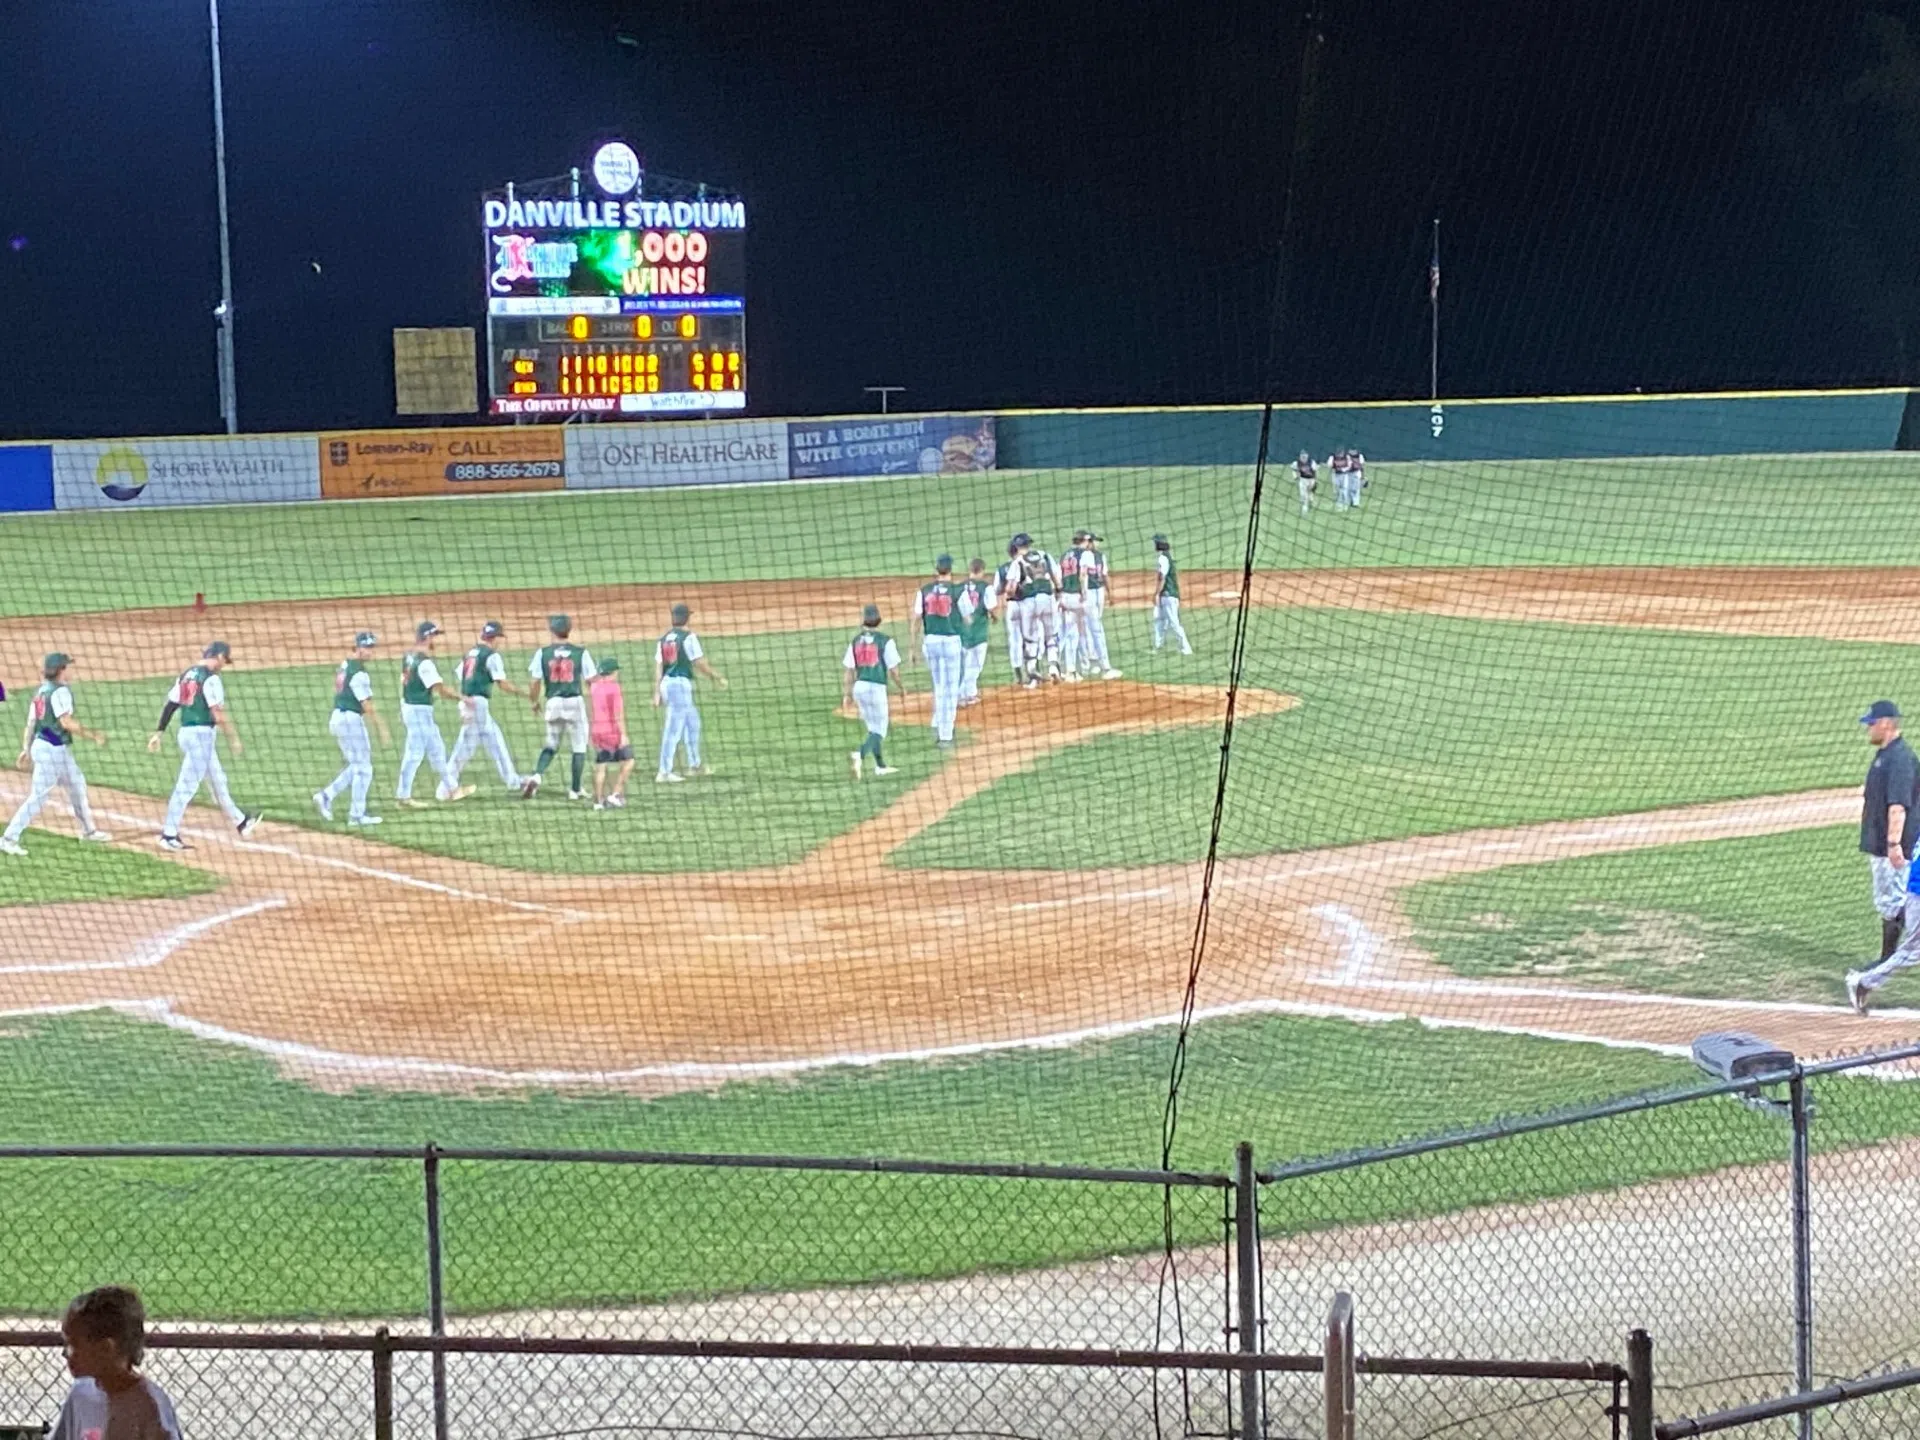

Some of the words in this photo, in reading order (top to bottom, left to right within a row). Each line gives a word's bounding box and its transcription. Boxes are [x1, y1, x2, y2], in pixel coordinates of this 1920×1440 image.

[485, 201, 620, 228] DANVILLE
[624, 202, 746, 229] STADIUM
[622, 266, 706, 295] WINS!
[571, 397, 616, 411] FAMILY
[447, 440, 498, 456] CALL
[603, 444, 642, 467] OSF
[797, 446, 843, 464] WITH
[455, 462, 561, 479] 888-566-2679
